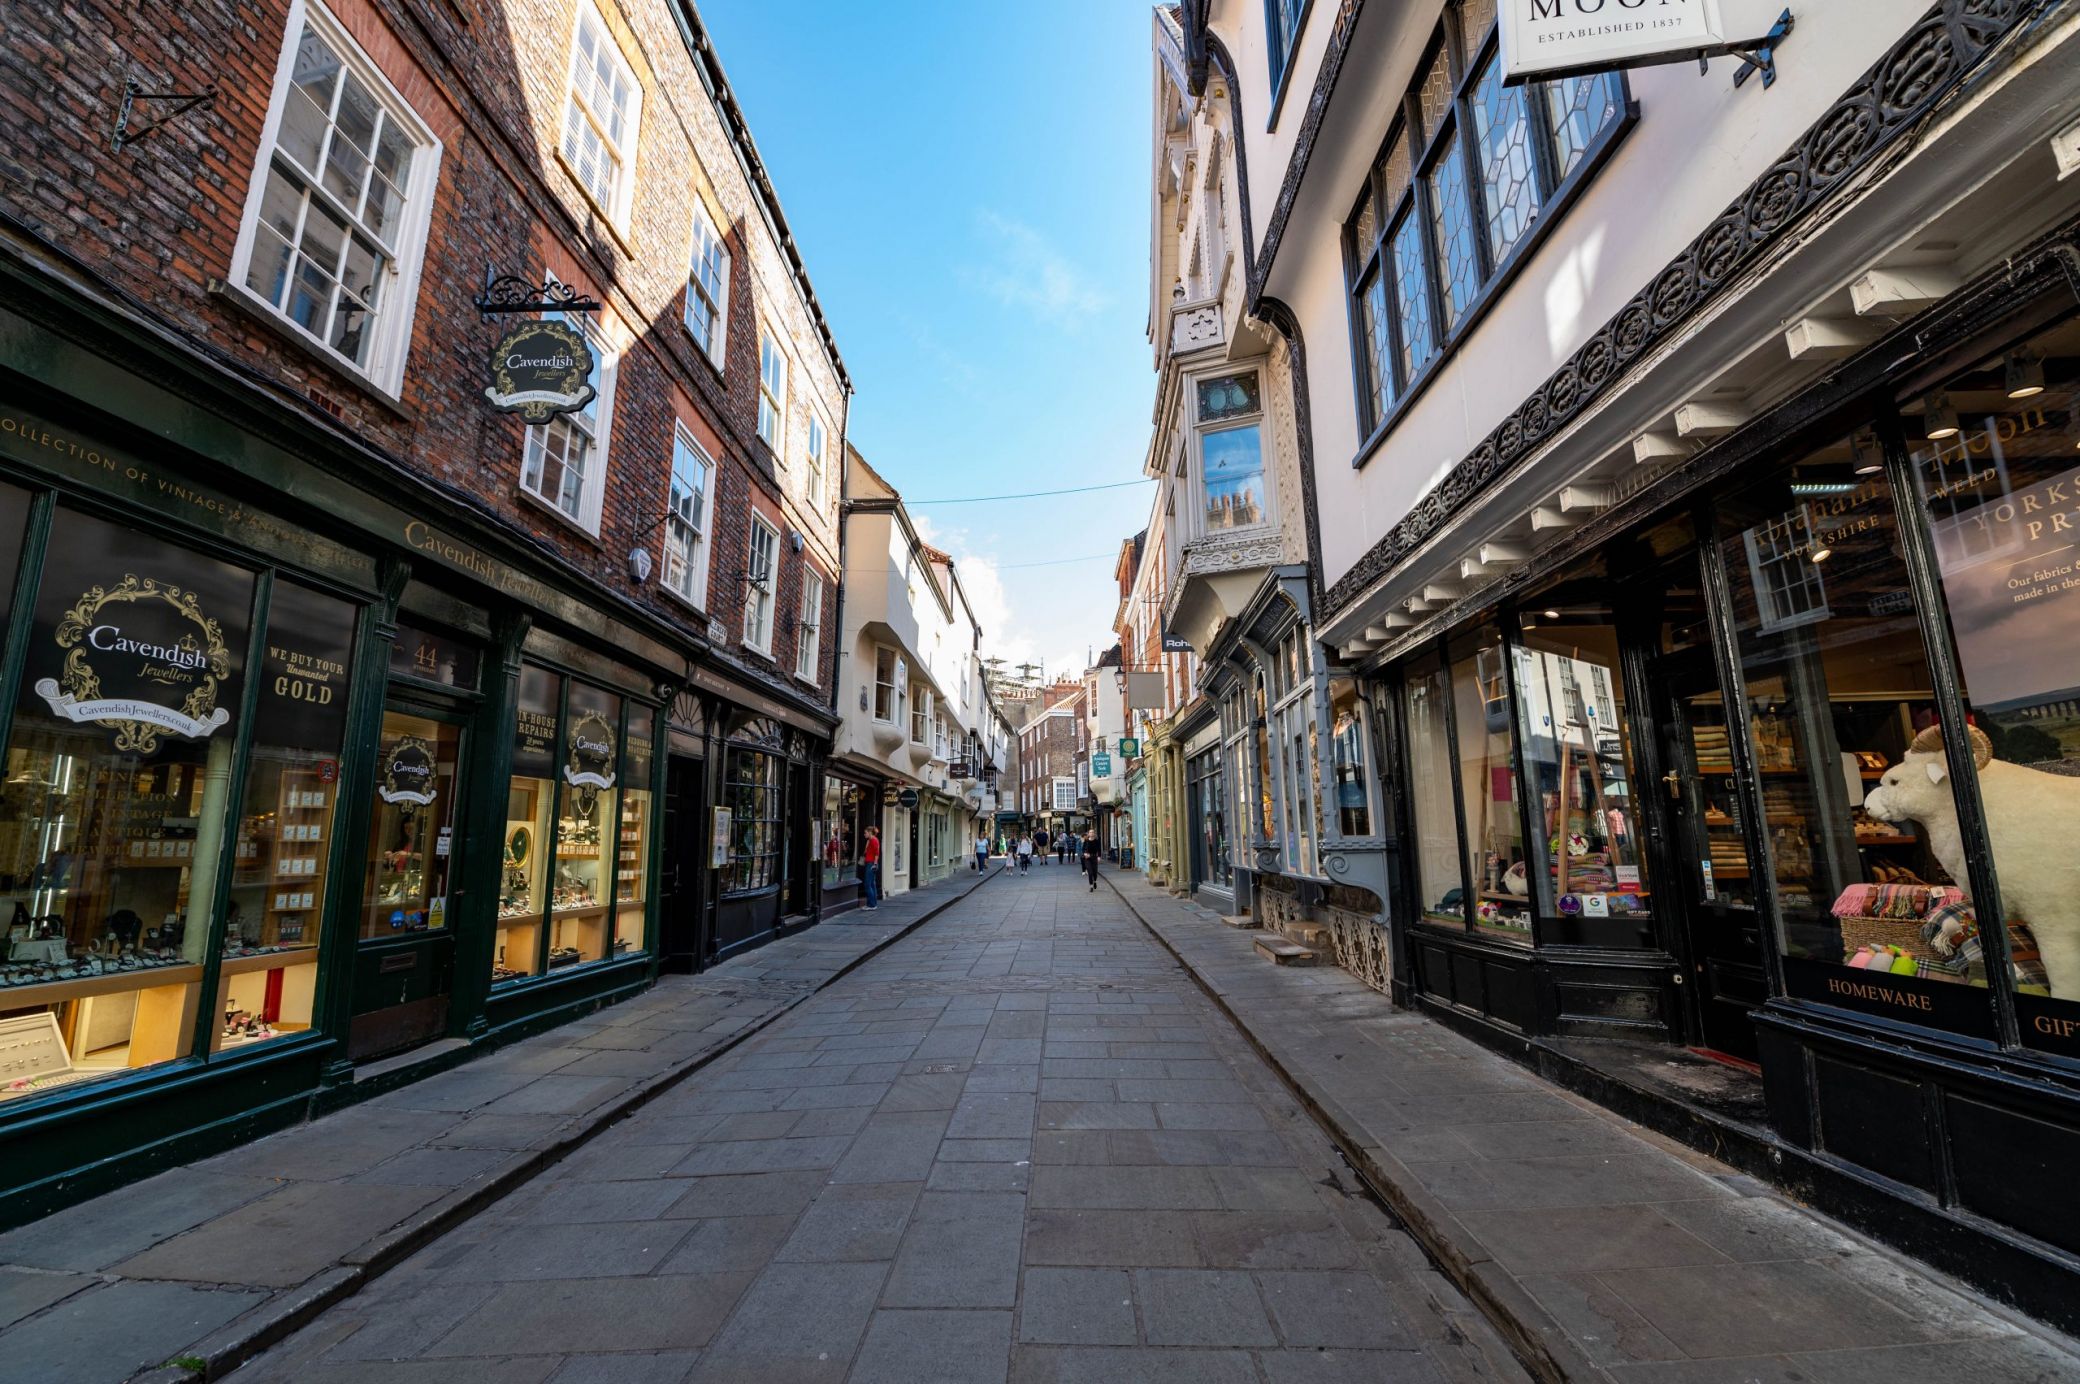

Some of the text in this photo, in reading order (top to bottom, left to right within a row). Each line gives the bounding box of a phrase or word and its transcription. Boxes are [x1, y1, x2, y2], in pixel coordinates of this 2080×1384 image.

[1538, 17, 1682, 43] ESTABLISHED 1837
[506, 354, 573, 369] Cavendish
[533, 369, 566, 380] Jewellers
[1930, 405, 2048, 473] Moon
[1, 418, 116, 471] OLLECTION
[126, 467, 149, 483] OF
[159, 479, 225, 514] VINTAGE
[233, 510, 242, 521] &
[2027, 505, 2080, 542] PR
[1783, 514, 1880, 560] YORKSHIRE
[404, 521, 557, 608] Cavendish Jewellers
[2008, 574, 2031, 589] Our
[2034, 564, 2072, 583] fabrics
[2014, 576, 2080, 603] made in the
[88, 625, 207, 670] Cavendish
[414, 645, 437, 667] 44
[1166, 639, 1191, 647] Roh
[137, 663, 193, 684] Jewellers
[270, 646, 344, 675] WE BUY YOUR
[286, 663, 329, 682] Unwanted
[275, 676, 332, 704] GOLD
[79, 704, 193, 731] CavendishJewellers.co.uk
[518, 710, 556, 728] IN-HOUSE
[519, 723, 554, 739] REPAIRS
[576, 735, 610, 753] Cavendish
[393, 760, 430, 776] Cavendish
[1828, 977, 1933, 1012] HOMEWARE
